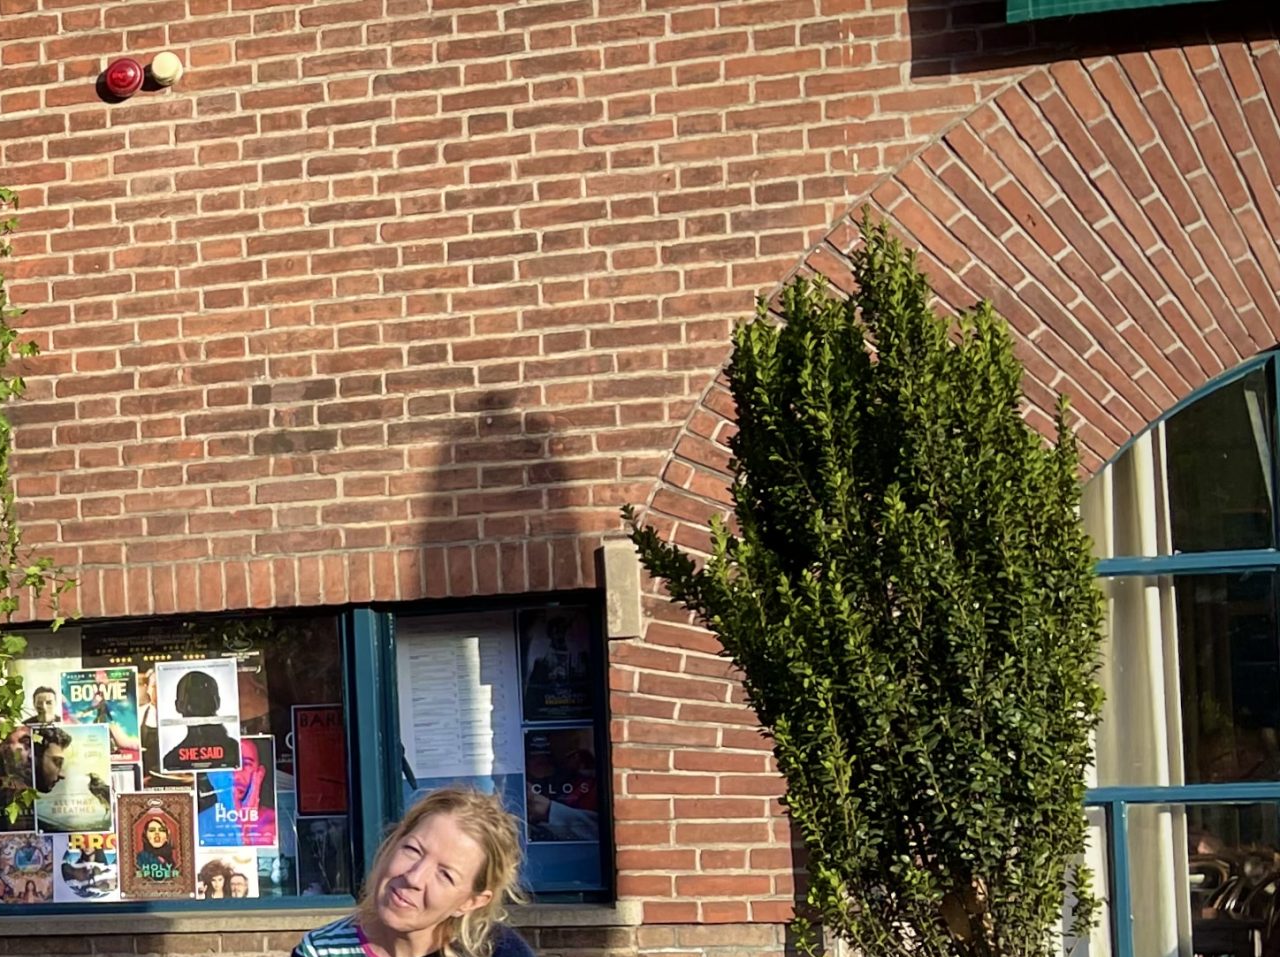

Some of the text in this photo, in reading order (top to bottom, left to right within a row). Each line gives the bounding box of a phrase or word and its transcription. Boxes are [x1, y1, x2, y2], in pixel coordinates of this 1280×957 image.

[70, 681, 128, 702] BOWIE
[178, 746, 224, 761] SHE SAID
[215, 807, 259, 822] HOUB
[136, 870, 180, 878] SPIDER
[142, 863, 173, 871] HOLY
